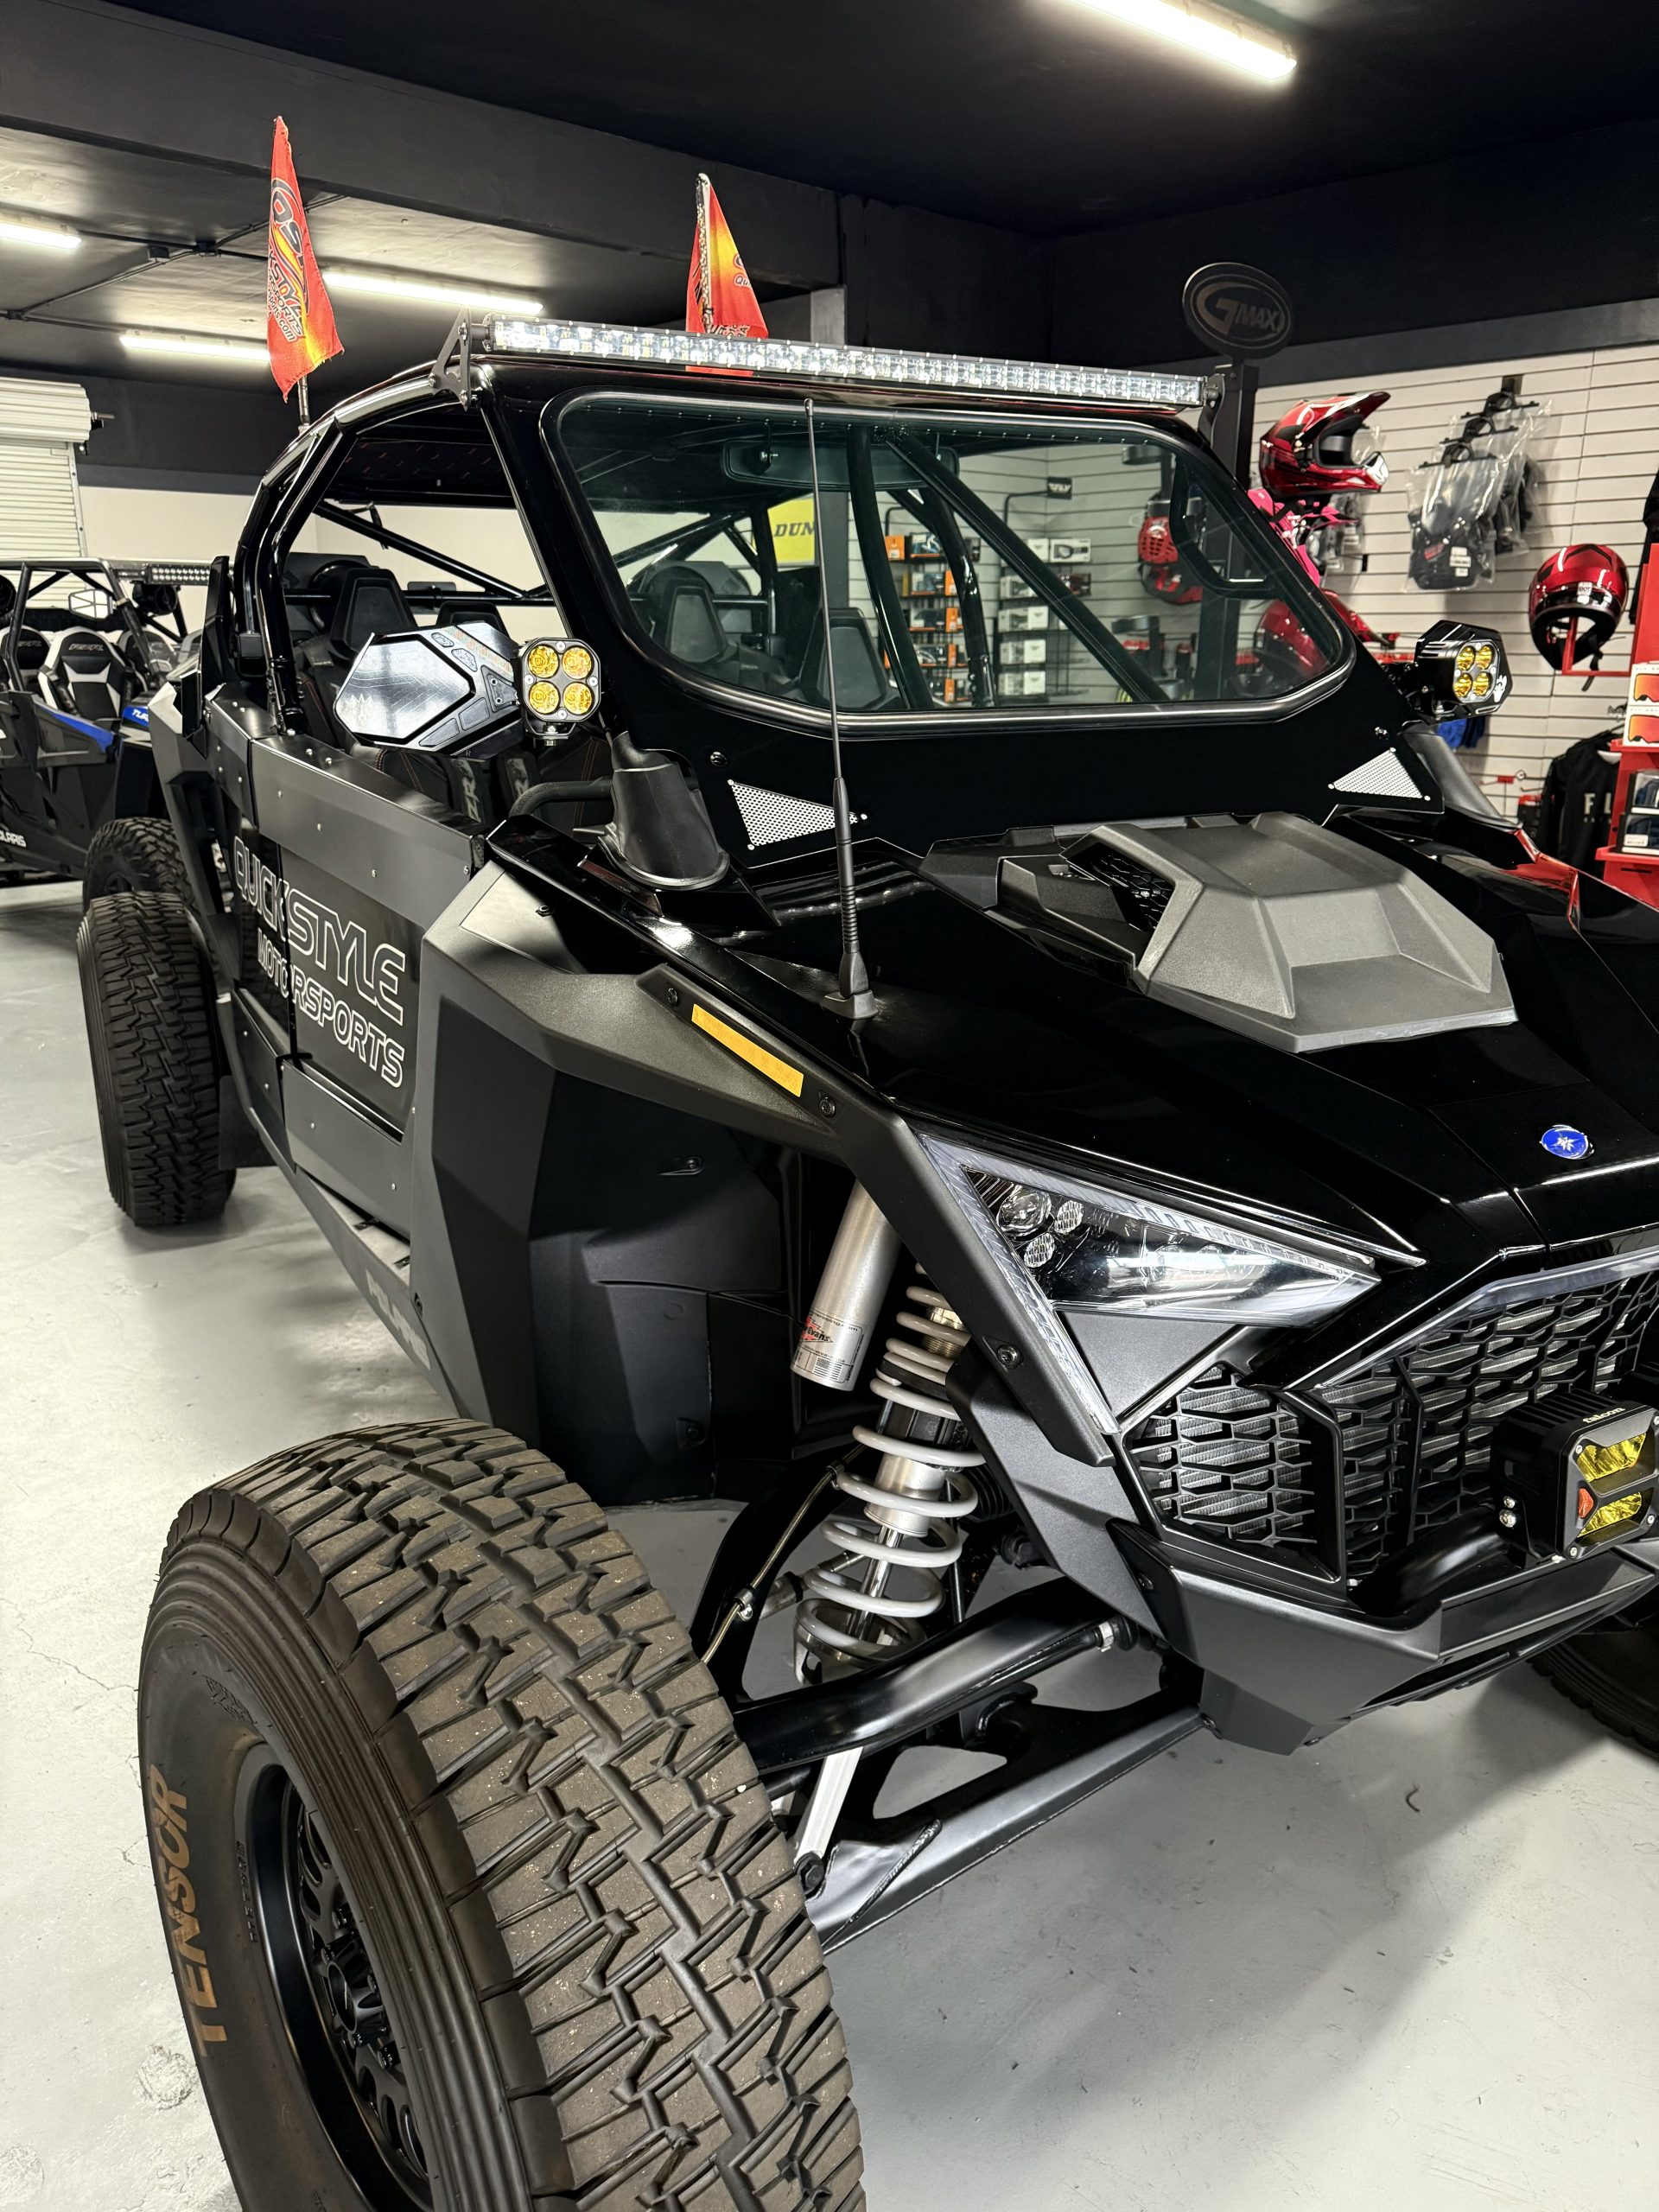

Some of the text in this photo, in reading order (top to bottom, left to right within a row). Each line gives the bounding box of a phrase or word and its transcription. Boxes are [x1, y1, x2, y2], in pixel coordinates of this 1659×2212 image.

[1197, 282, 1279, 335] GMAX
[774, 522, 814, 537] DUN
[1584, 792, 1611, 815] FL
[257, 927, 405, 1088] MOTORSPORTS
[1582, 1408, 1626, 1424] falcon
[149, 1763, 228, 2058] TENSOR
